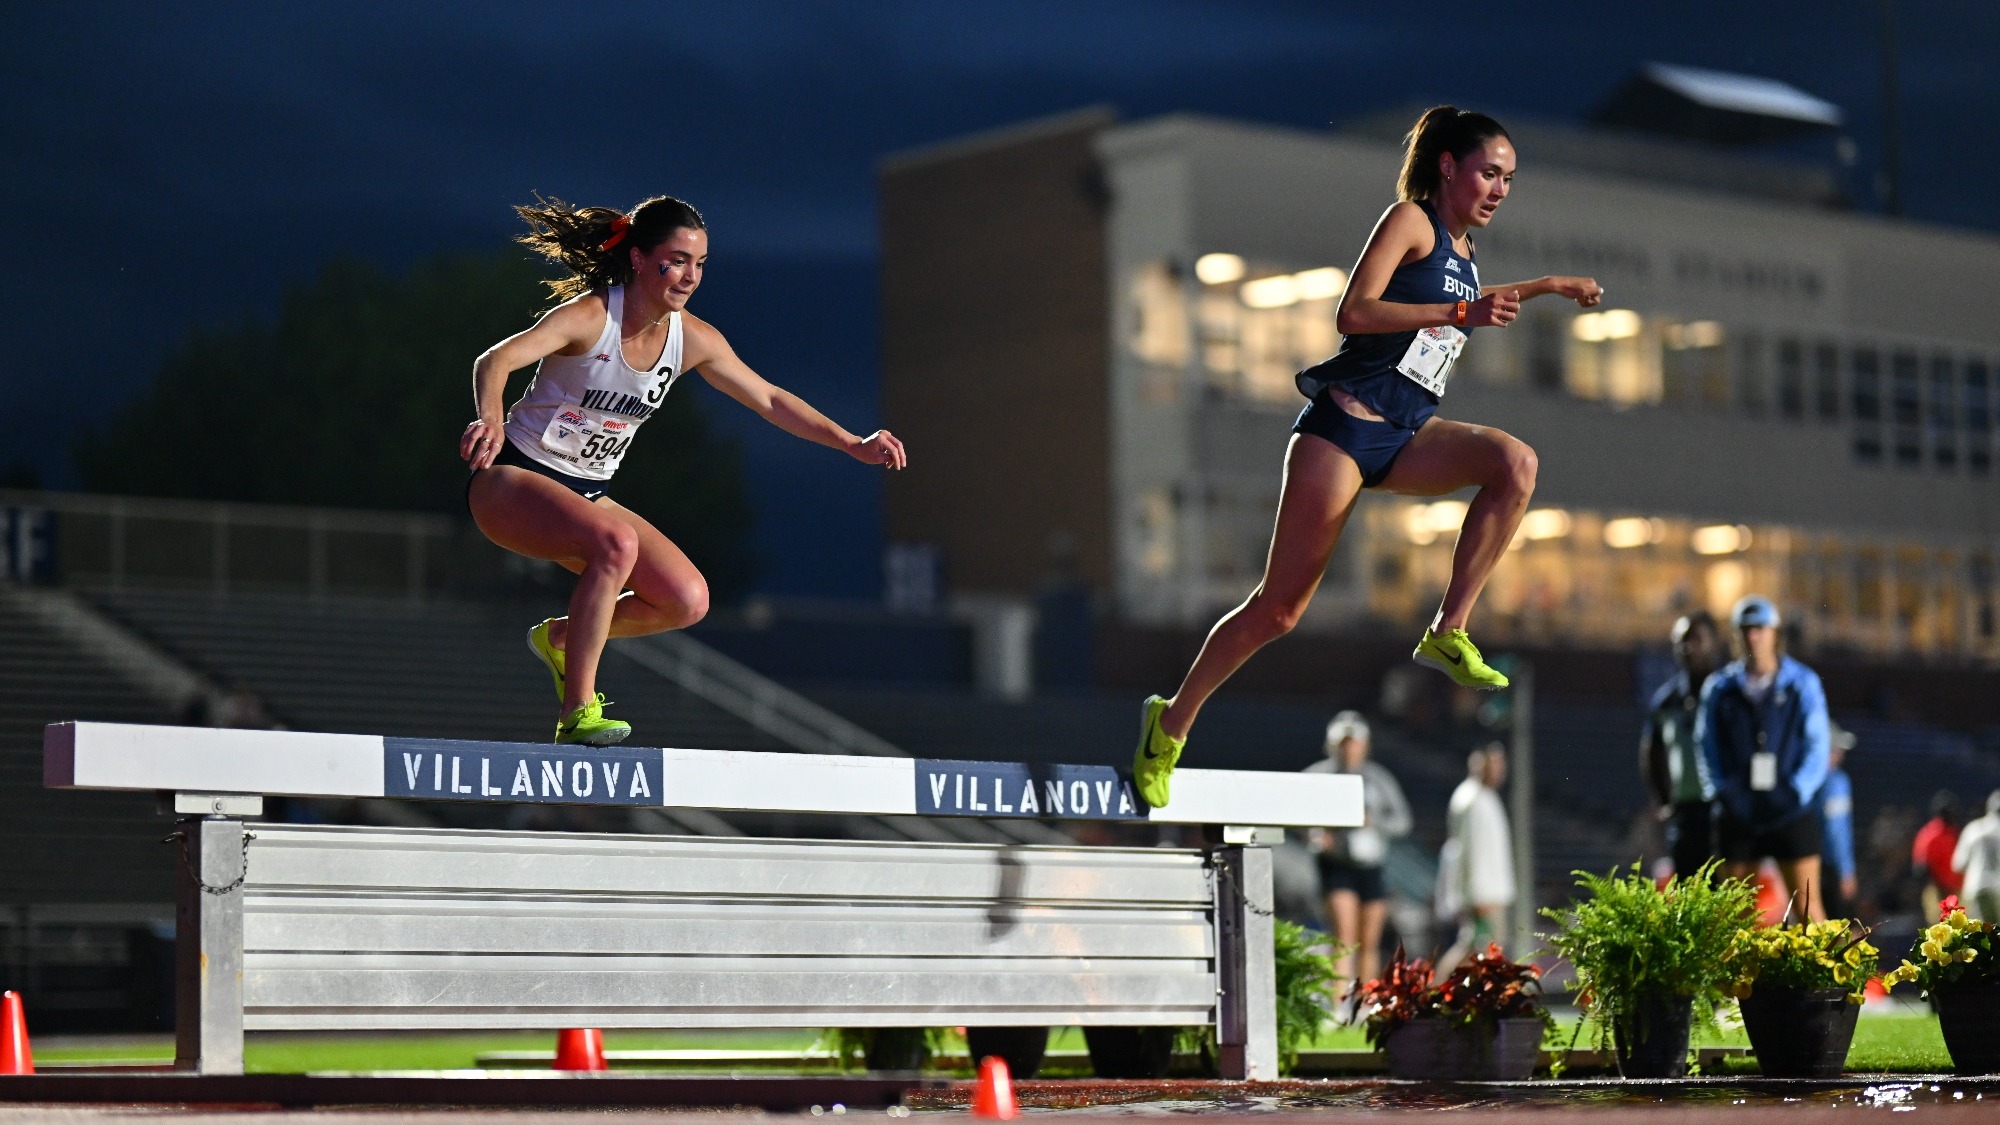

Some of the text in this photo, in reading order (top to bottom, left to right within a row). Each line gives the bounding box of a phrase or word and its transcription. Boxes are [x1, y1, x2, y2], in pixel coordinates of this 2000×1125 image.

[648, 367, 673, 404] 3
[1406, 367, 1424, 382] TIMING
[581, 434, 631, 460] 594
[403, 752, 651, 798] VILLANOVA
[929, 773, 1137, 815] VILLANOVA
